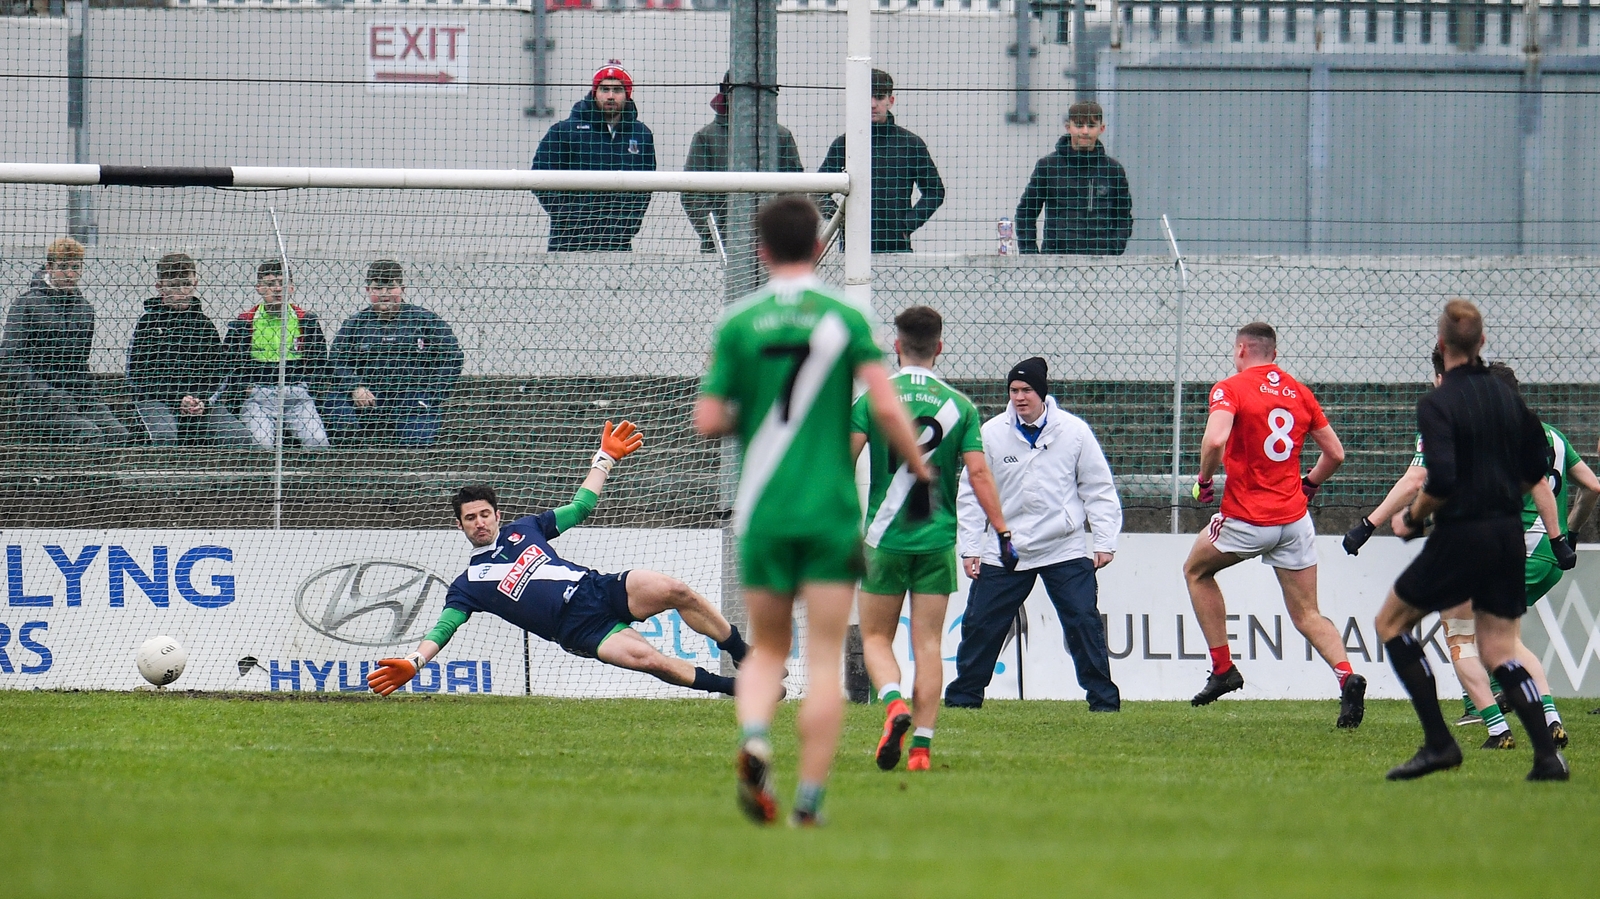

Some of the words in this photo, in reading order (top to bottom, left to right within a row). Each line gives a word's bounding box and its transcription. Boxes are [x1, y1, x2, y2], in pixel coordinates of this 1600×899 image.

[370, 26, 465, 60] EXIT
[761, 342, 811, 423] 7
[896, 393, 913, 402] HE
[915, 392, 942, 407] SASH
[1263, 407, 1295, 462] 8
[6, 544, 236, 608] LYNG
[501, 546, 539, 592] FINLAY
[512, 571, 531, 598] MOTOR
[1063, 613, 1282, 660] ULLEN
[1306, 616, 1451, 663] AK
[270, 659, 492, 692] HYUDAI
